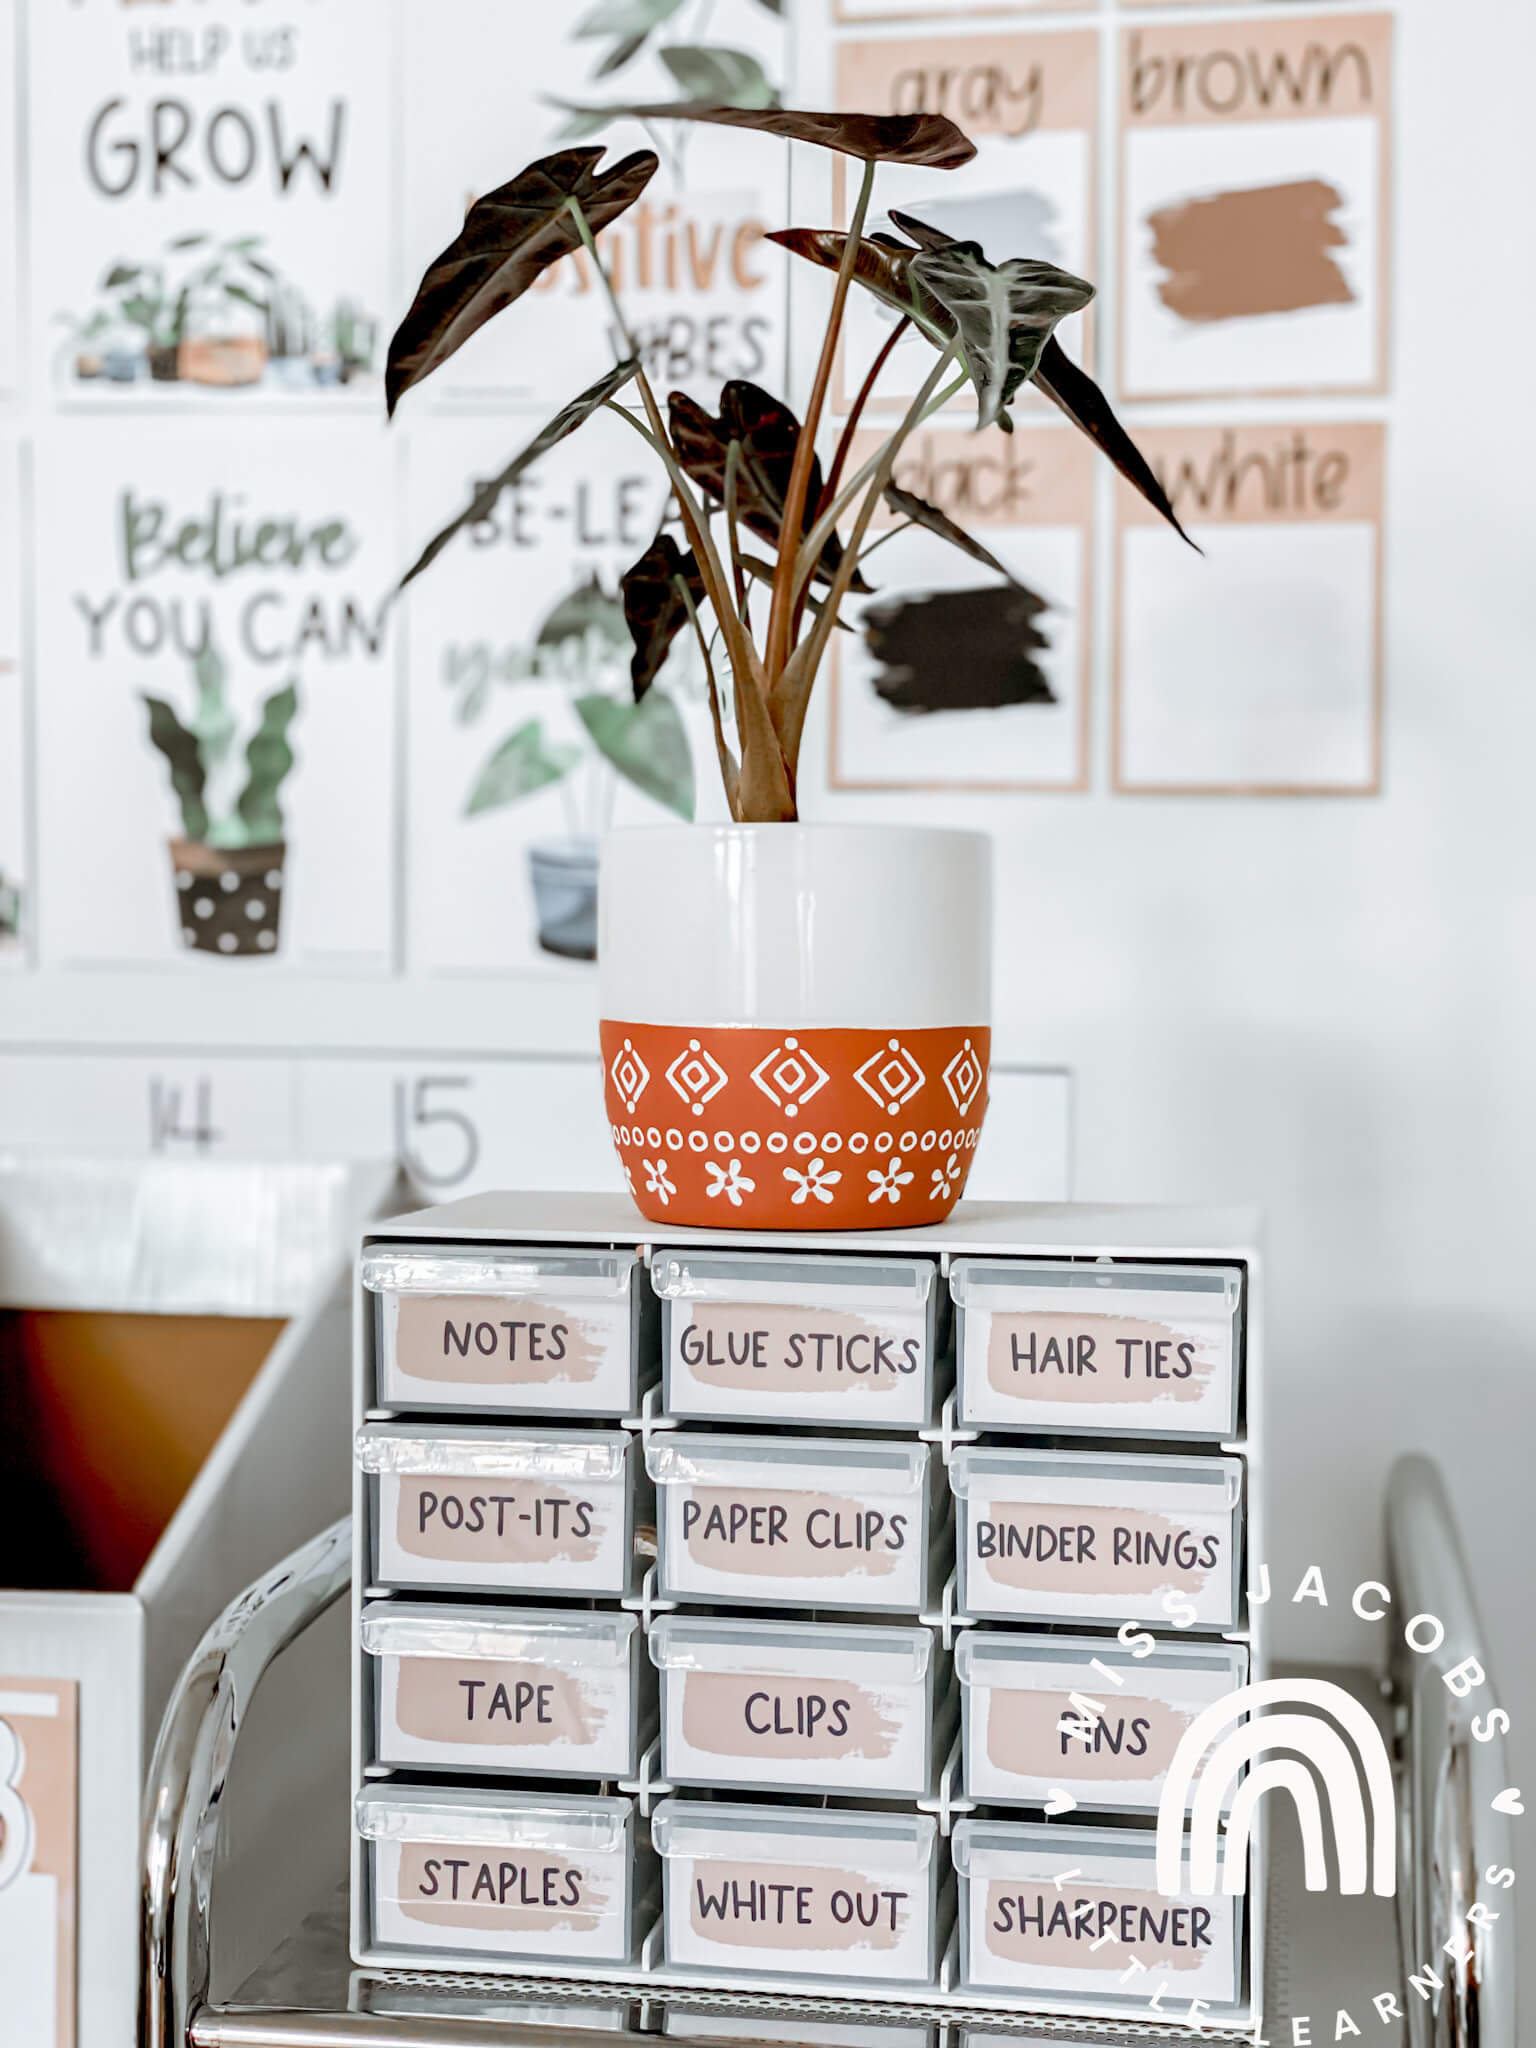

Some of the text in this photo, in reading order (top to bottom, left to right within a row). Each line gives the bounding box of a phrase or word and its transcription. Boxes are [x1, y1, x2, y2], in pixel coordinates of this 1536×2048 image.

[128, 26, 298, 74] HELP US
[1126, 36, 1373, 114] brown
[88, 97, 346, 197] GROW
[1153, 428, 1350, 512] white
[119, 487, 358, 580] Believe
[76, 590, 390, 664] YOU CAN
[147, 1073, 222, 1155] 14
[392, 1073, 480, 1188] 15
[443, 1319, 569, 1361] NOTES
[680, 1324, 921, 1376] GLUE STICKS
[1010, 1331, 1196, 1379] HAIR TIES
[418, 1491, 595, 1540] POST-ITS
[682, 1500, 908, 1552] PAPER CLIPS
[976, 1521, 1220, 1570] BINDER RINGS
[458, 1679, 555, 1724] TAPE
[744, 1692, 852, 1738] CLIPS
[1060, 1711, 1151, 1756] PINS
[418, 1859, 583, 1907] STAPLES
[696, 1878, 909, 1932] WHITE OUT
[993, 1895, 1213, 1949] SHARPENER
